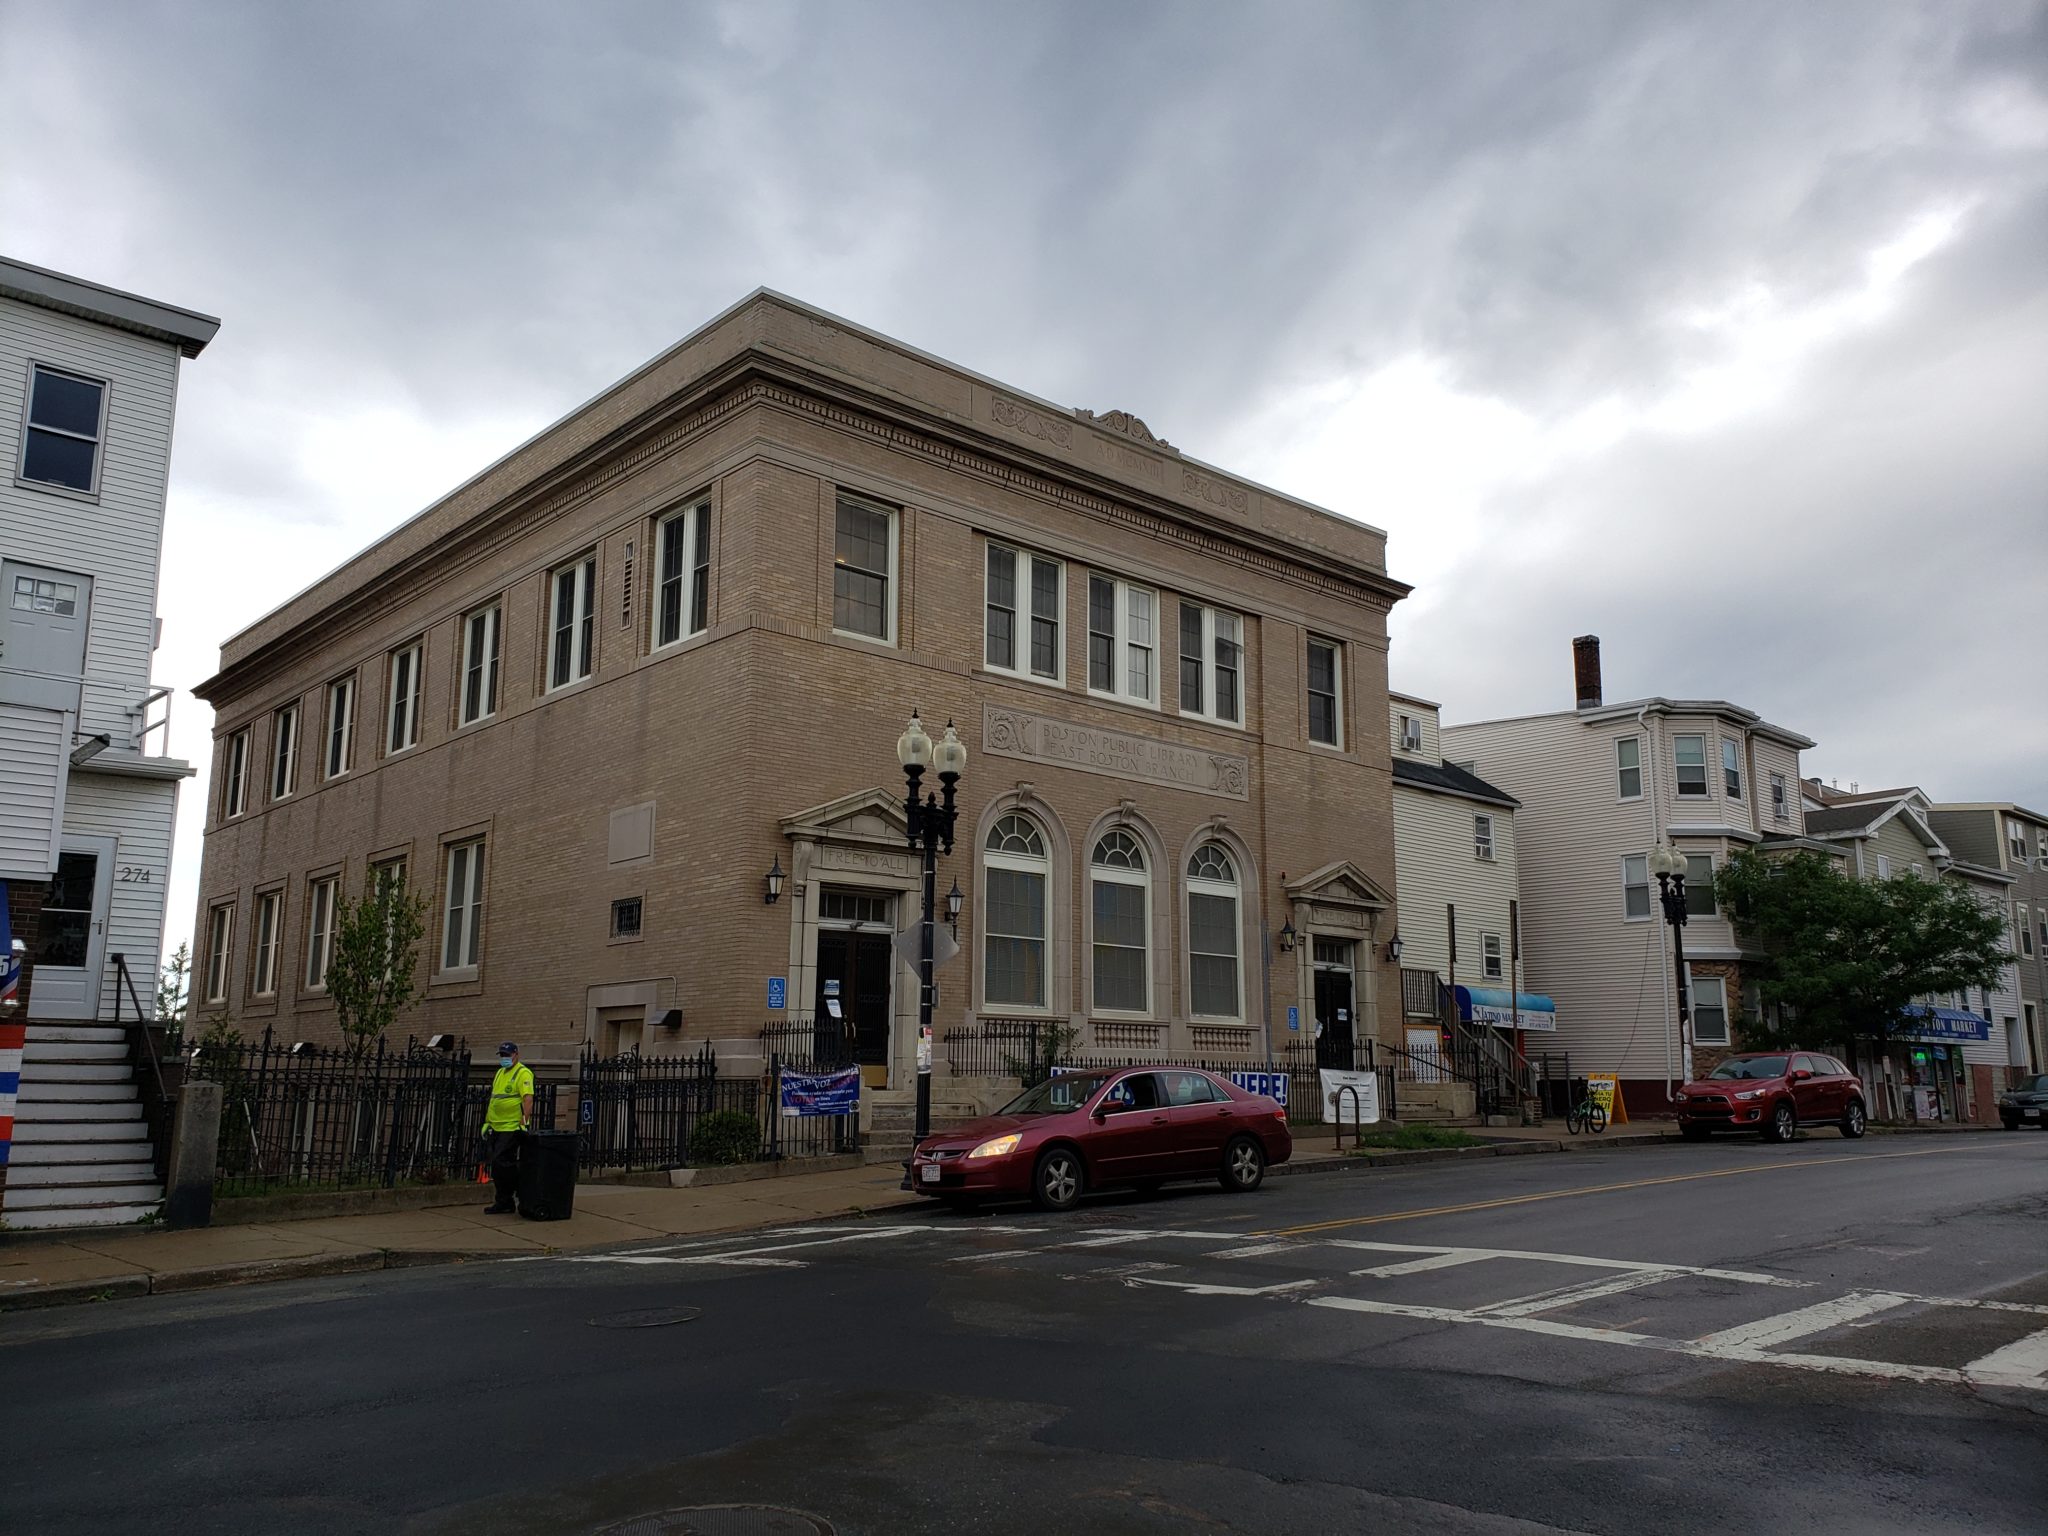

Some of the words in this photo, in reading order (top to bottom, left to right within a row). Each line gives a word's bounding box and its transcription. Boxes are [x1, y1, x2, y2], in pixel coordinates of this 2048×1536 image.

[1043, 724, 1097, 747] BOSTON
[1102, 736, 1145, 757] PUBLIC
[1149, 746, 1200, 768] LIBRARY
[1049, 742, 1084, 761] EAST
[1089, 750, 1139, 771] BOSTON
[1145, 761, 1195, 783] BRANCH
[827, 849, 859, 865] FREE
[863, 853, 879, 867] TO
[881, 856, 904, 870] ALL
[122, 867, 150, 883] 274
[1481, 1007, 1501, 1023] LATINO
[1950, 1019, 1978, 1034] MARKET
[782, 1078, 816, 1092] NUESTRA
[814, 1078, 831, 1089] VOZ
[1231, 1072, 1289, 1106] HERE!
